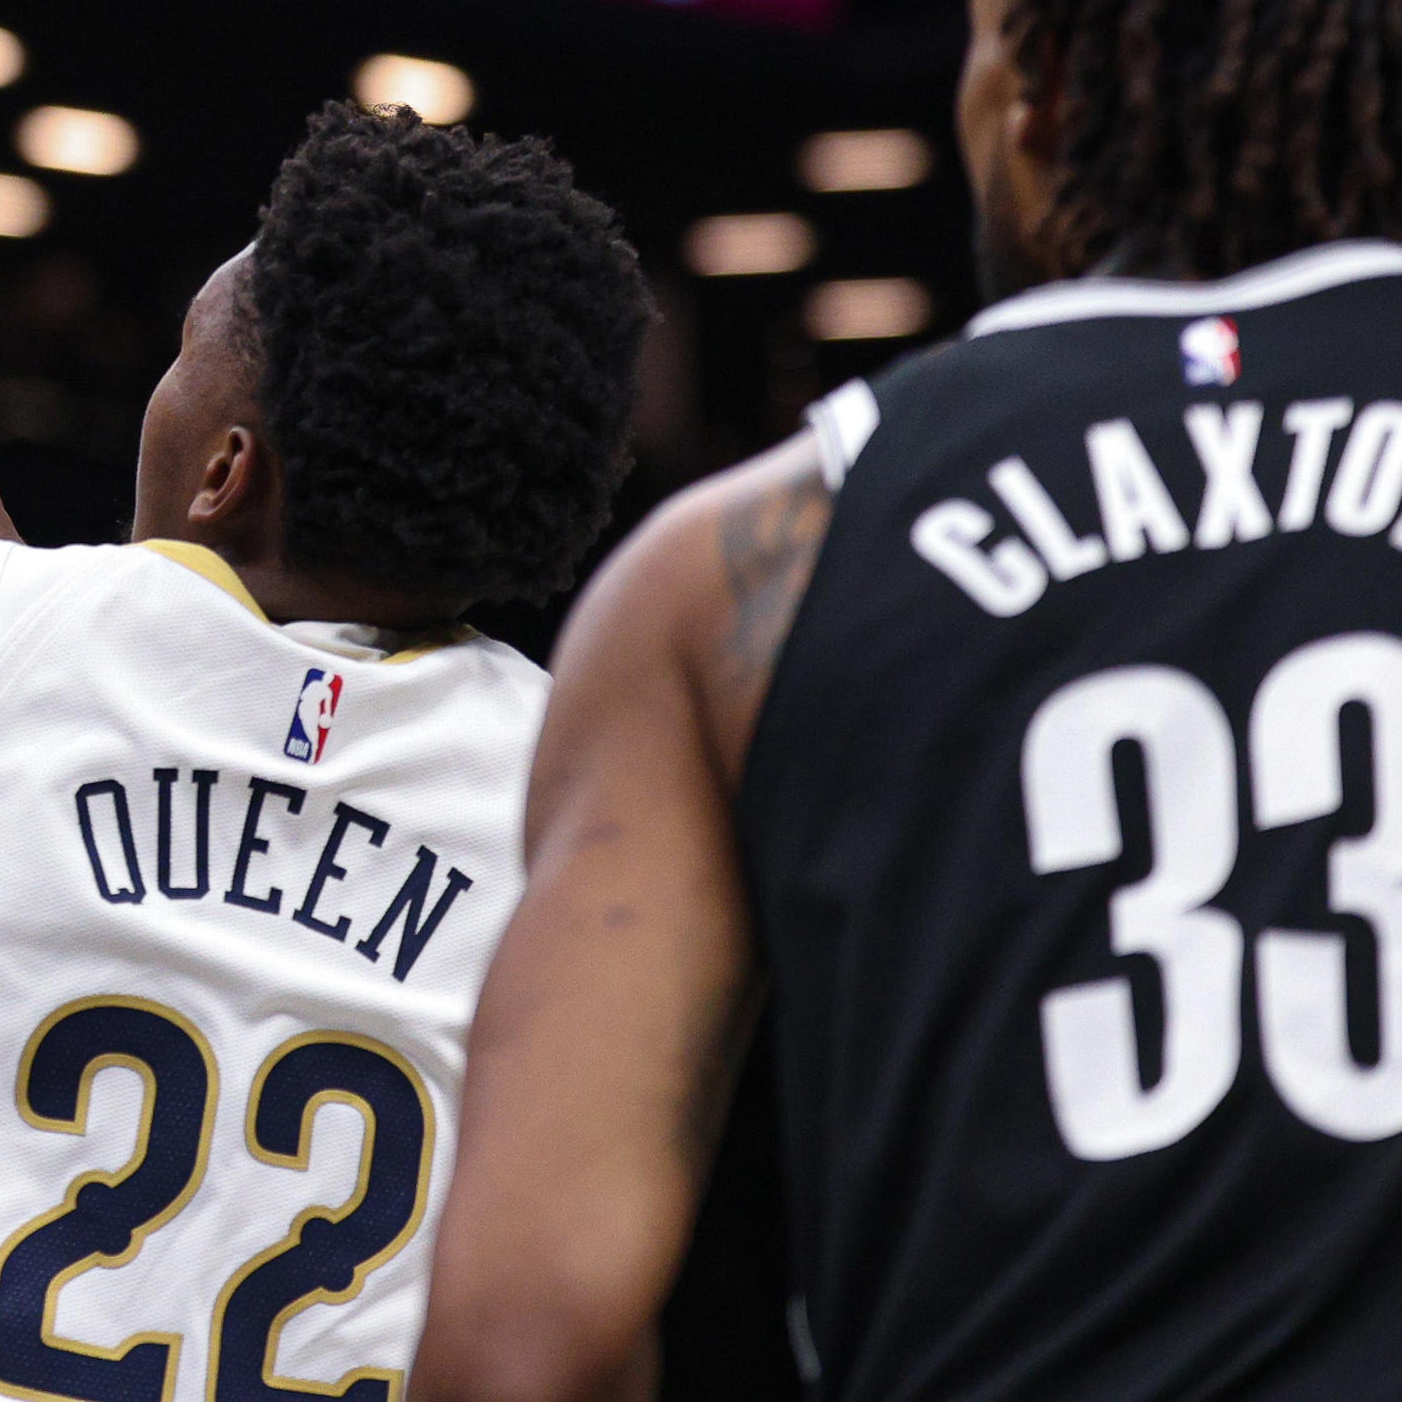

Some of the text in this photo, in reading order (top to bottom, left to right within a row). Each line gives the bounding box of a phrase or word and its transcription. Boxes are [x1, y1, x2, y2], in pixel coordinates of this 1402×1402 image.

[910, 395, 1402, 618] CLAXTO
[75, 767, 474, 984] QUEEN
[1021, 630, 1402, 1162] 33
